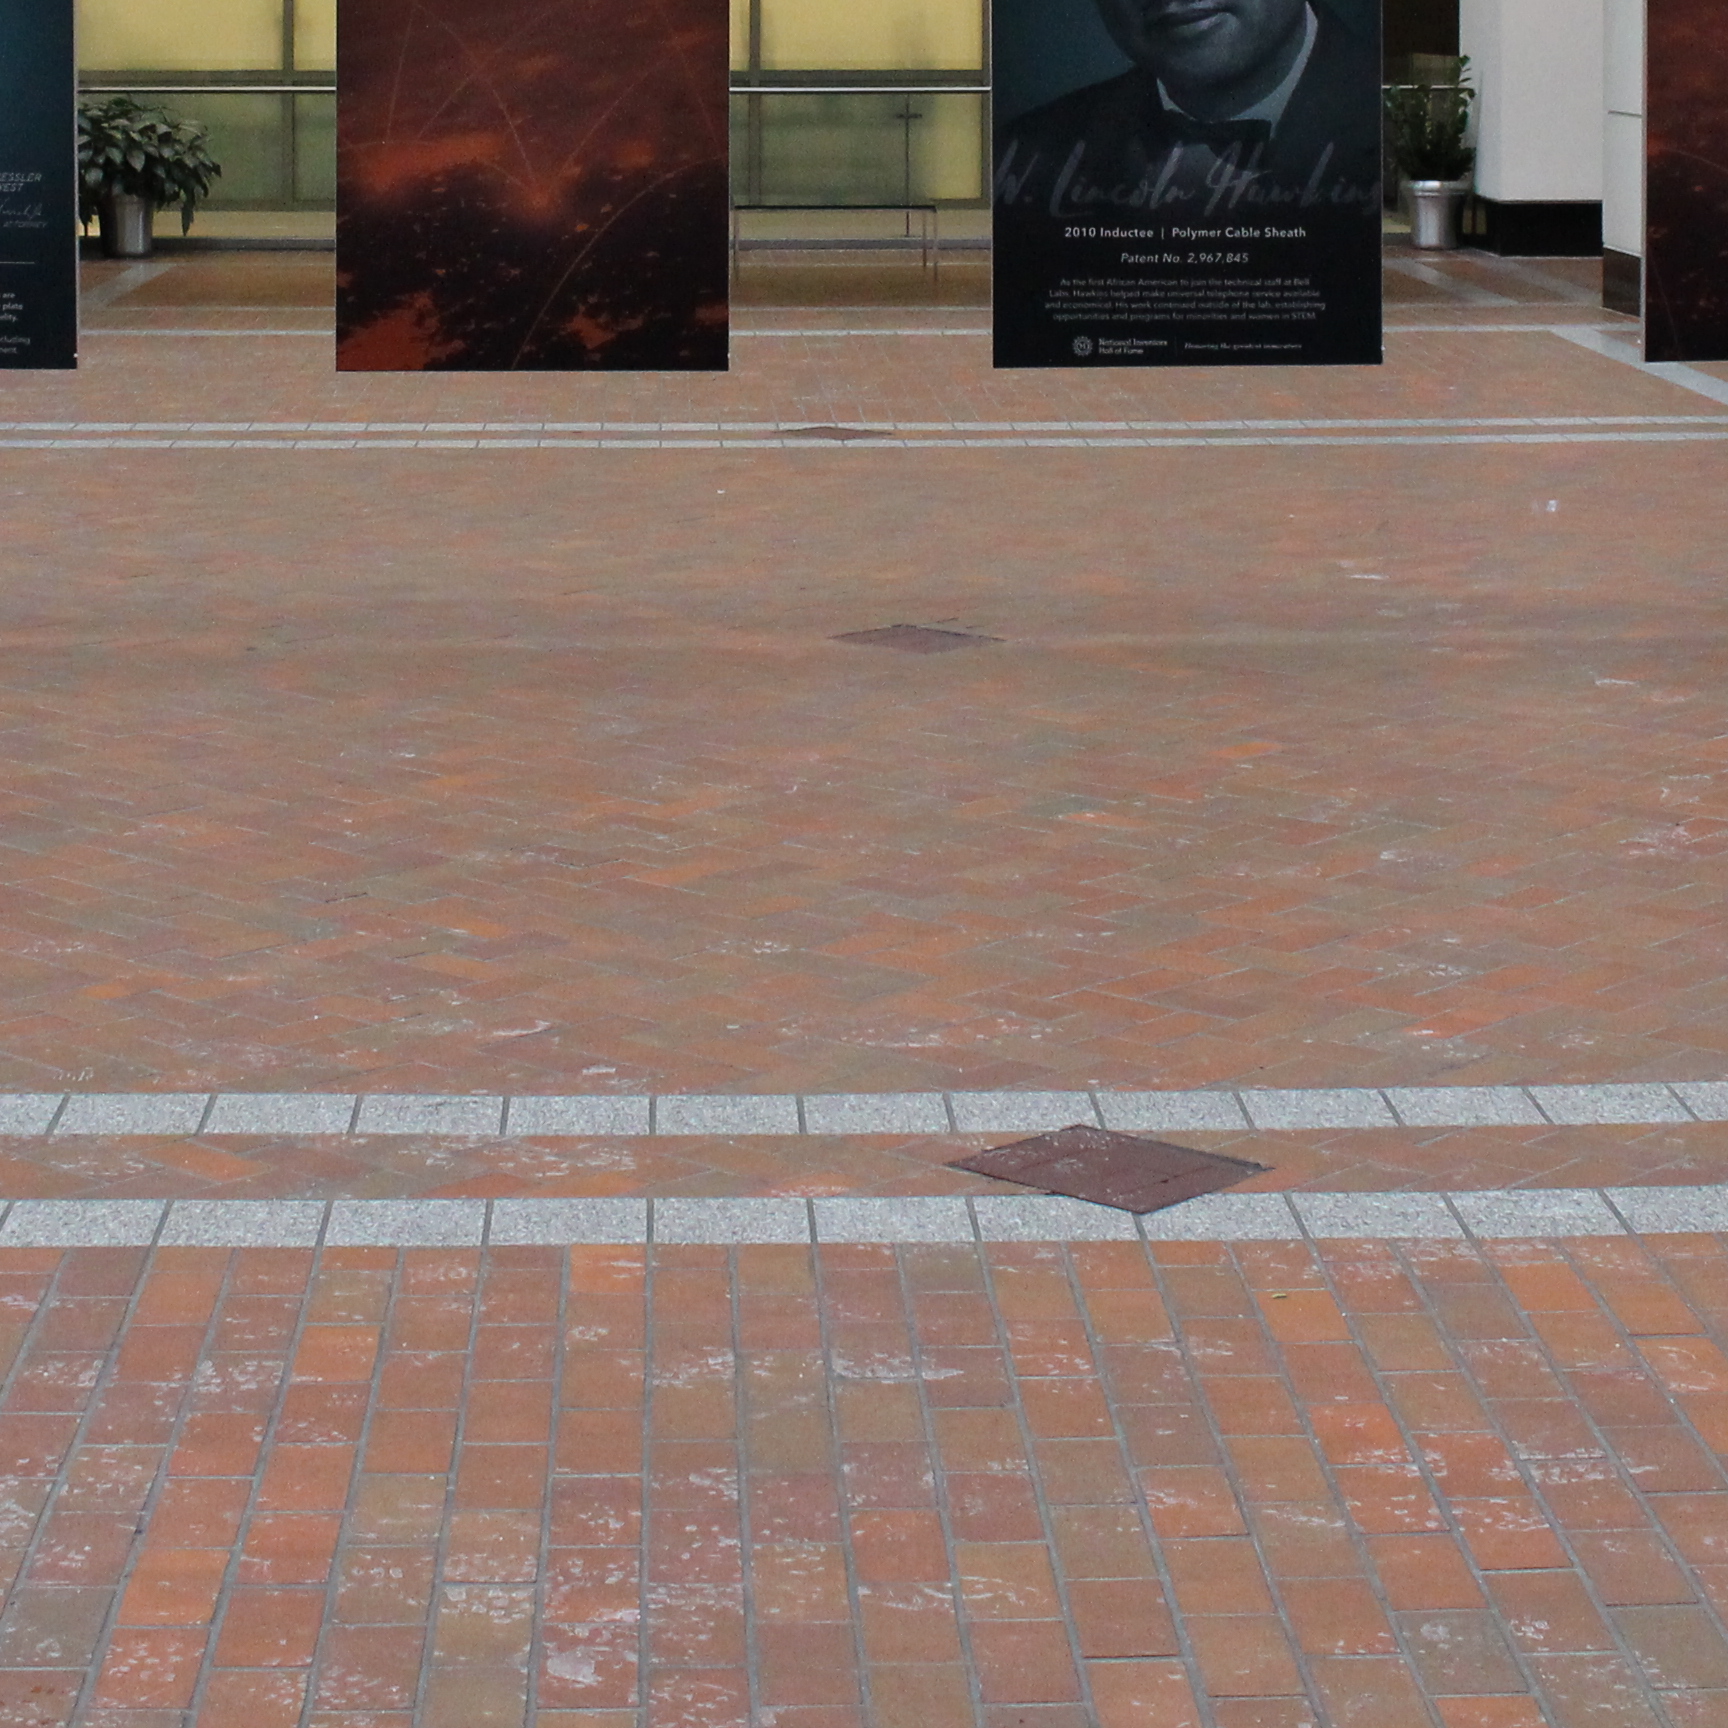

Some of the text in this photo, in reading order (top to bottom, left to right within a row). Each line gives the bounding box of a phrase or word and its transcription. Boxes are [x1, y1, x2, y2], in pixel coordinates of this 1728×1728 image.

[1065, 227, 1306, 240] 2010 Inductee Polymer Cable Sheath
[1120, 253, 1158, 263] Patent
[1187, 253, 1249, 264] 2,967,845
